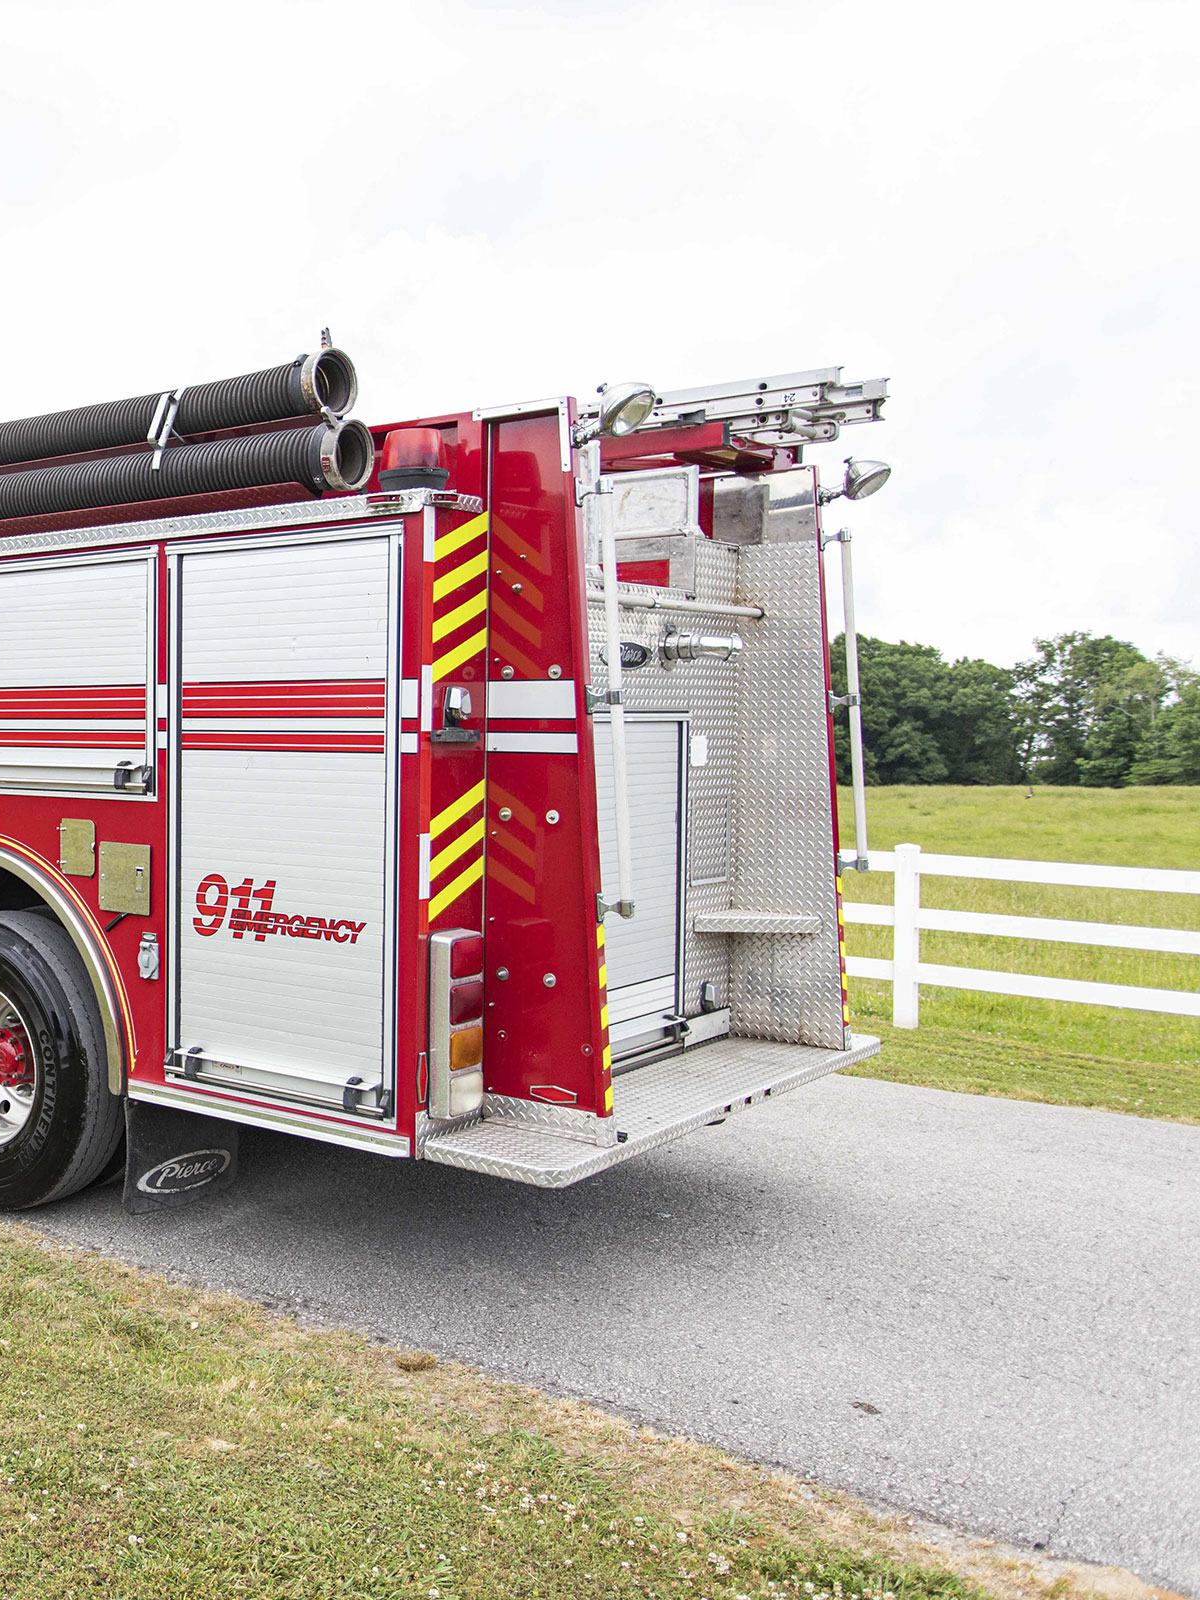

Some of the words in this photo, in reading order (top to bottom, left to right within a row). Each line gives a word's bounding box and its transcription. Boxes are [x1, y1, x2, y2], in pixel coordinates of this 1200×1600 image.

[783, 392, 796, 403] 24
[193, 873, 277, 942] 911
[228, 908, 367, 944] EMERGENCY
[17, 1029, 57, 1171] CONTINENTAL
[156, 1158, 217, 1187] Pierce
